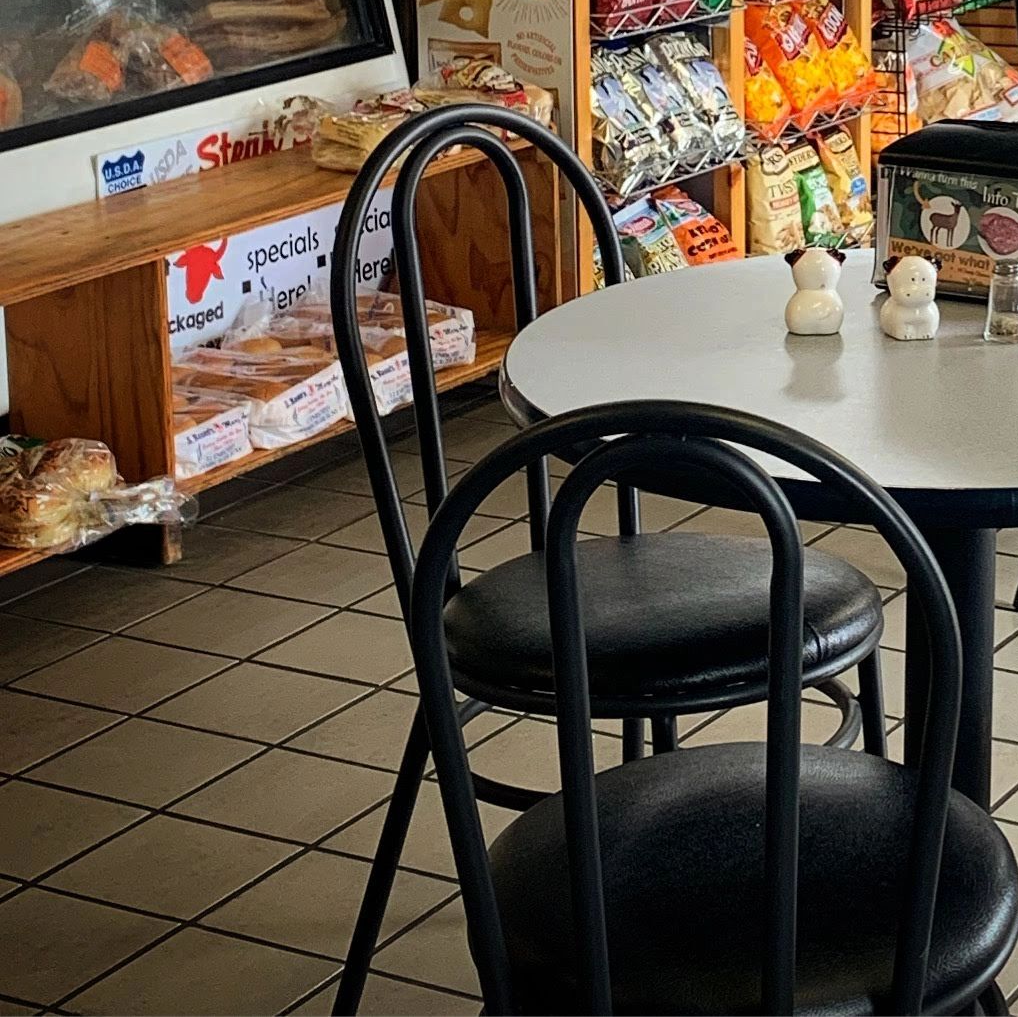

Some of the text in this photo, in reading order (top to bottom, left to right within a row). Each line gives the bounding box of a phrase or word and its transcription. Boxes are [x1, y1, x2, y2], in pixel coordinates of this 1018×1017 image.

[104, 161, 143, 181] U.S.D.A.
[900, 165, 978, 190] Wanna turn this
[107, 175, 142, 194] CHOICE
[982, 185, 1009, 207] Into
[247, 226, 320, 274] specials
[958, 254, 991, 270] what
